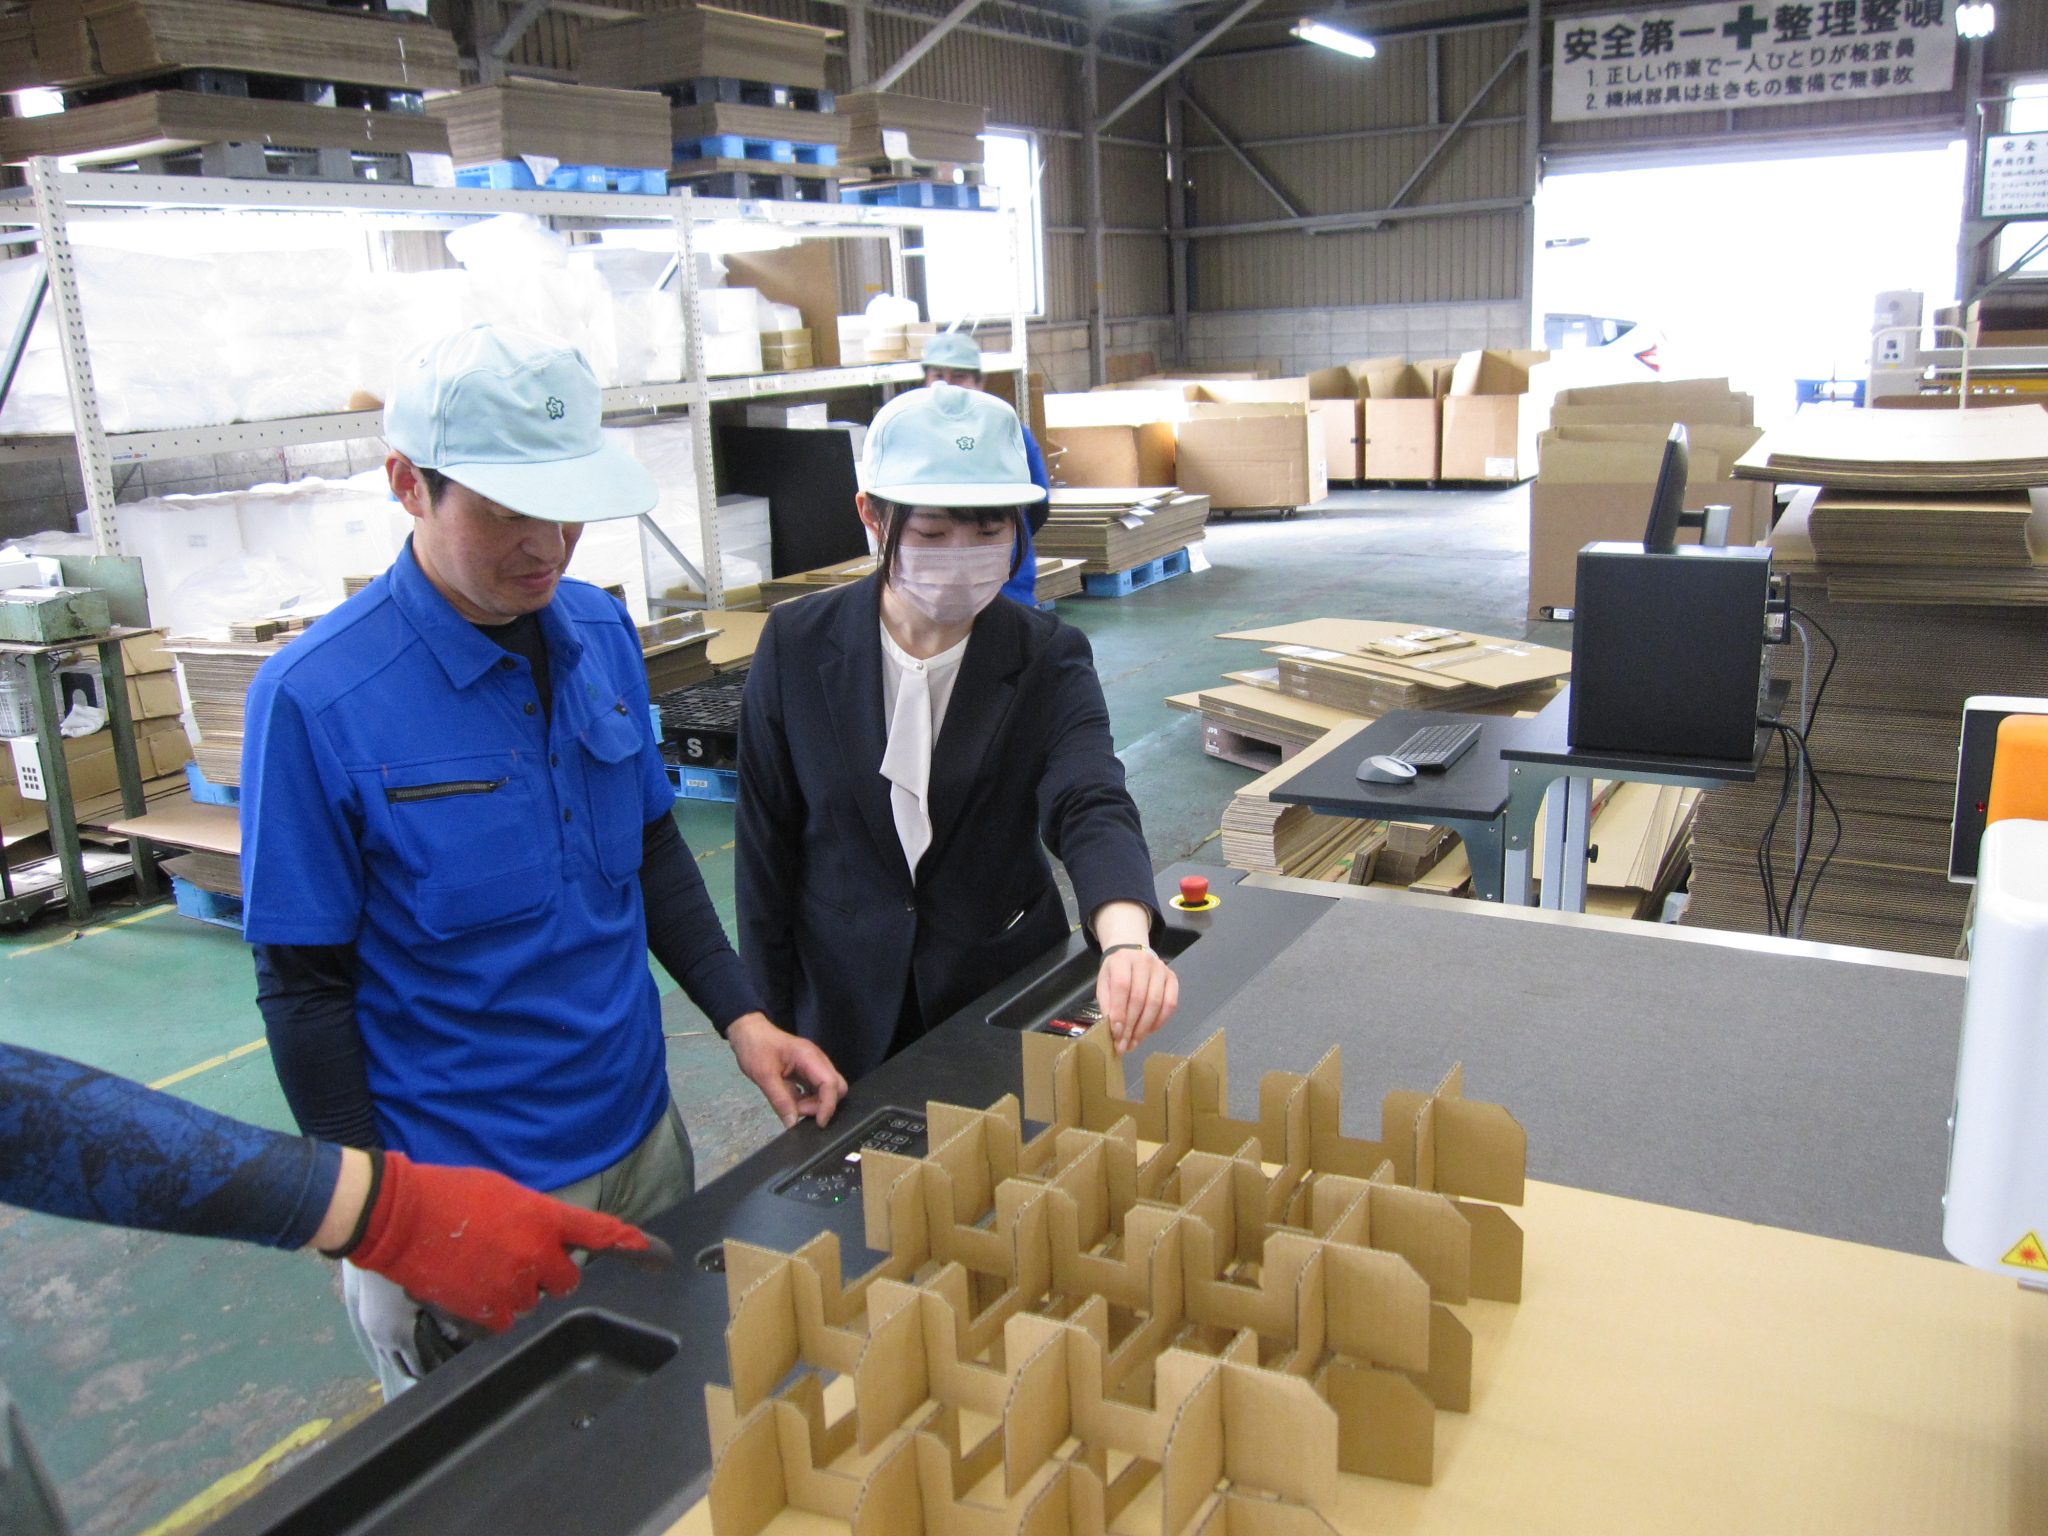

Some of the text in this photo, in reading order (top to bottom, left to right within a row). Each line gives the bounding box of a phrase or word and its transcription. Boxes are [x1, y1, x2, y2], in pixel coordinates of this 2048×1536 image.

[1563, 0, 1943, 64] 安全第一 整理整頓
[687, 737, 703, 758] S
